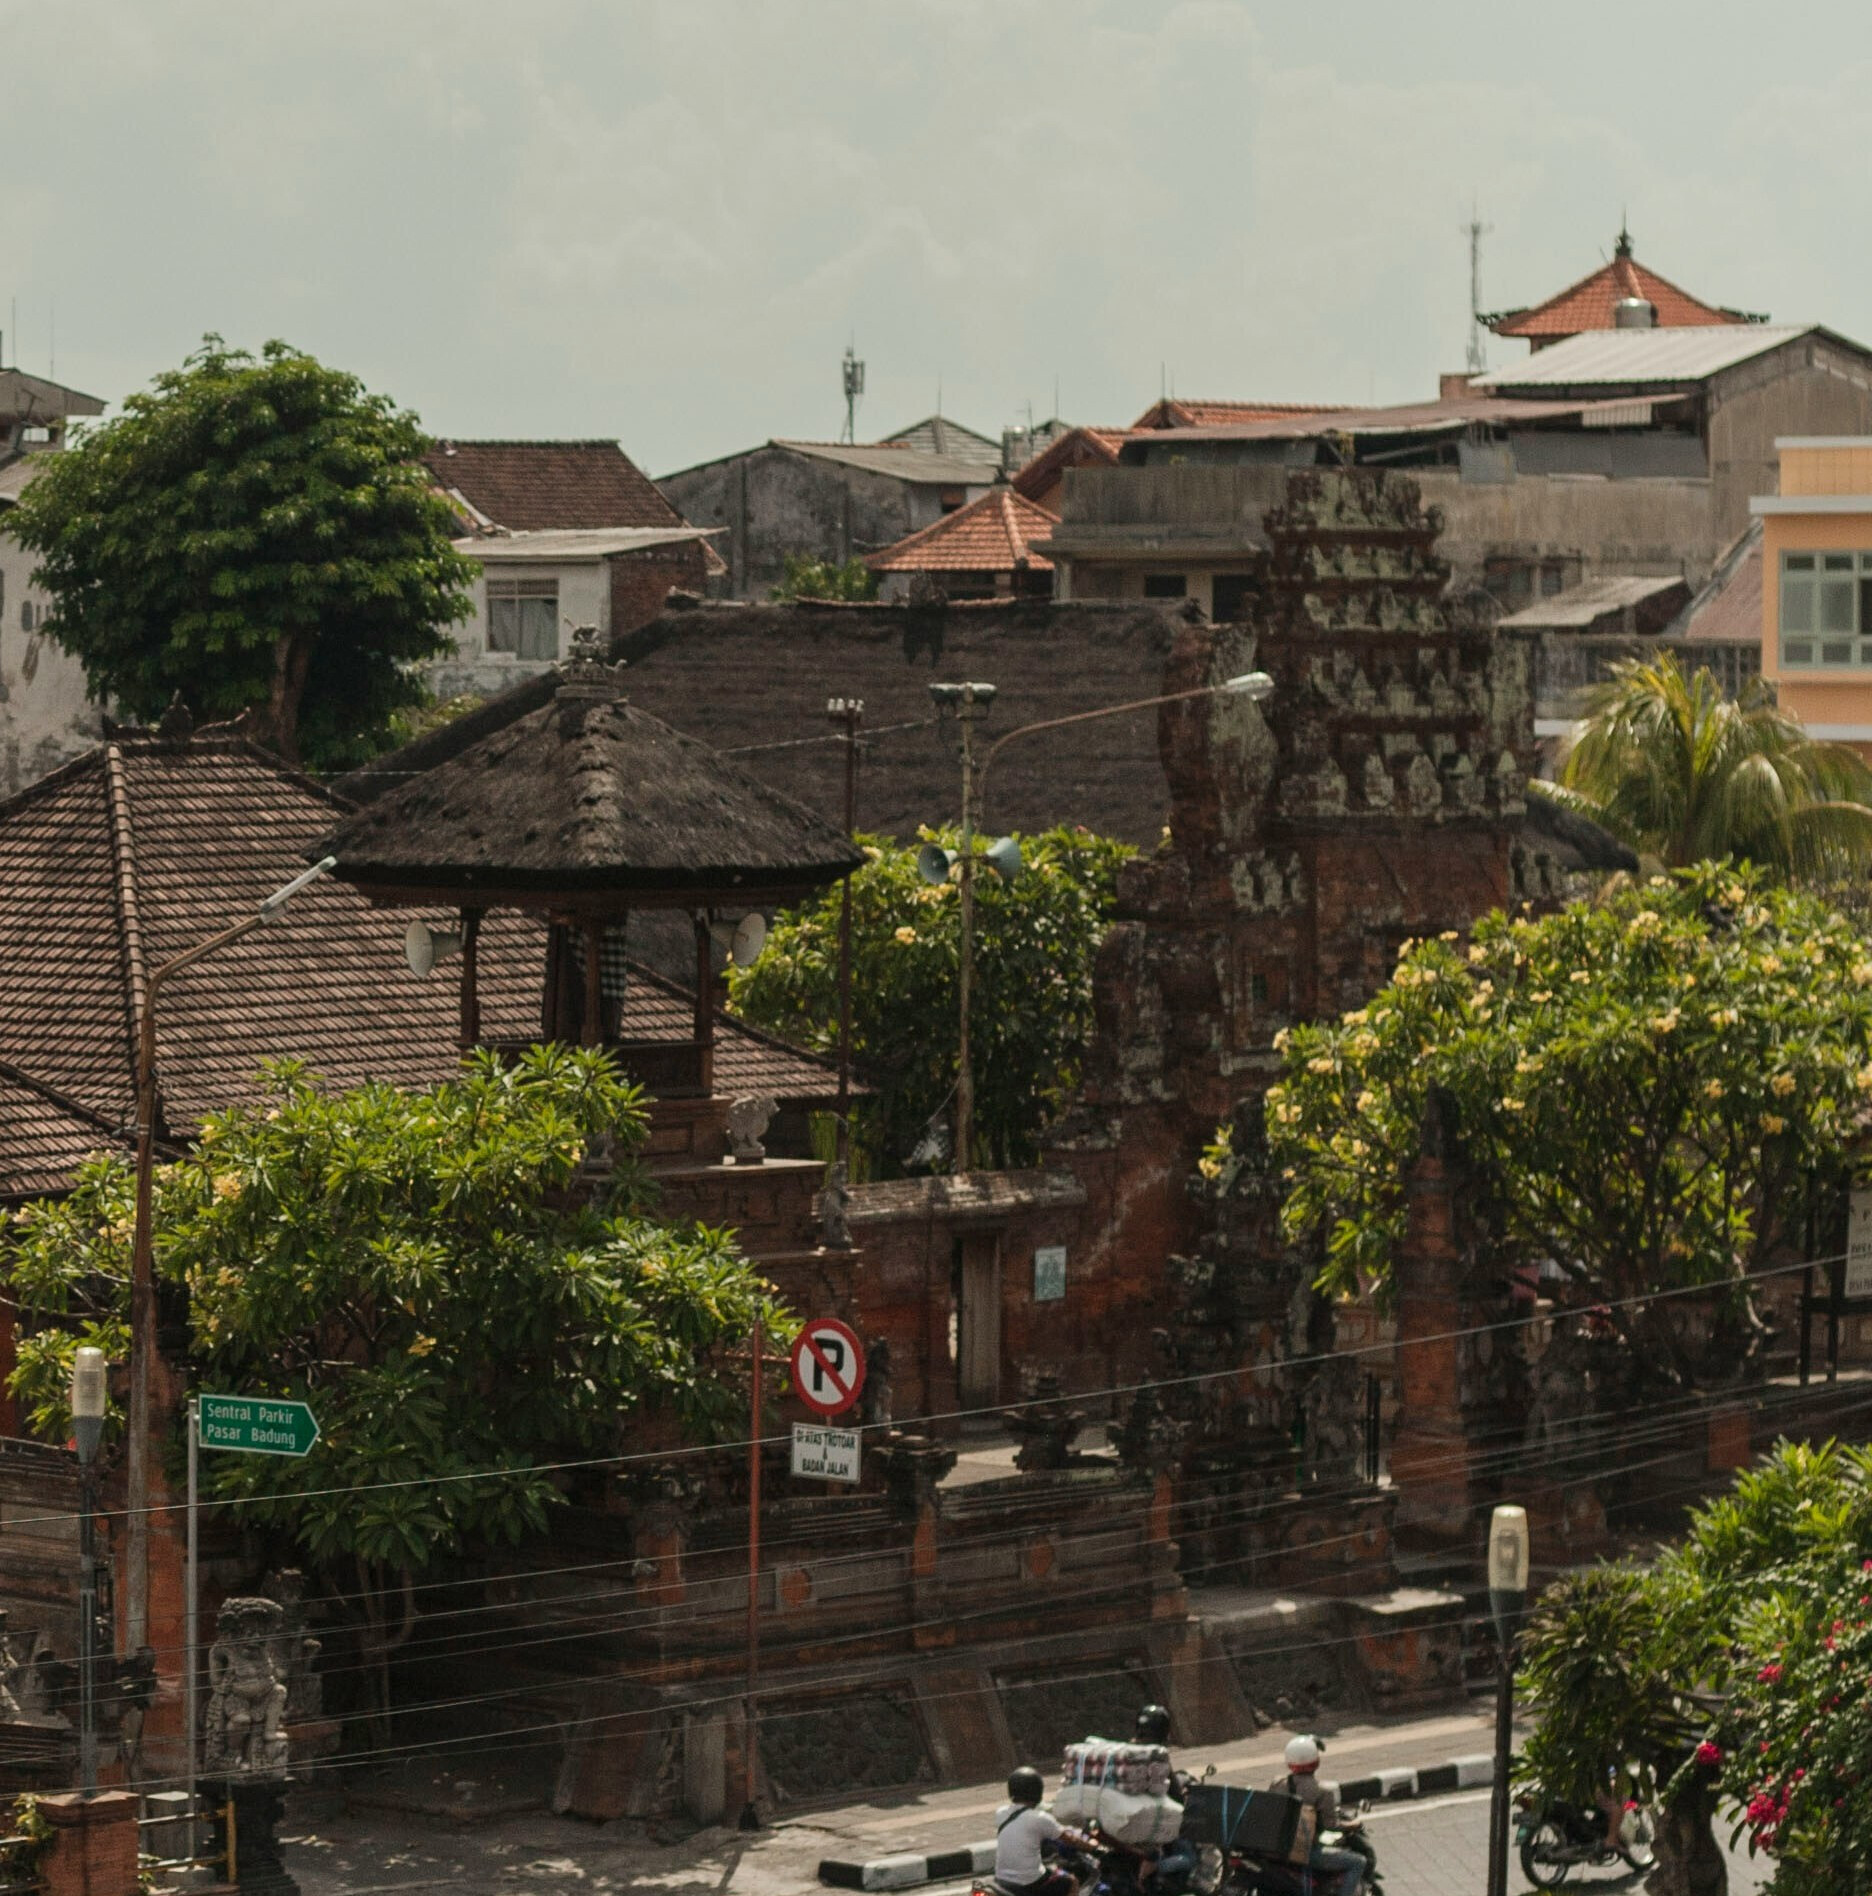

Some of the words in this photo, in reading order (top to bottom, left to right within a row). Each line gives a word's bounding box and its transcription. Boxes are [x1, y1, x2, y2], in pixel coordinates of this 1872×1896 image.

[813, 1337, 845, 1391] P
[207, 1403, 251, 1421] Sentral
[259, 1407, 294, 1424] Parkir
[207, 1424, 241, 1440] Pasar
[251, 1427, 296, 1449] Badung
[824, 1432, 855, 1449] TROTOAR
[802, 1458, 825, 1473] BADAN
[827, 1461, 849, 1475] JALAN
